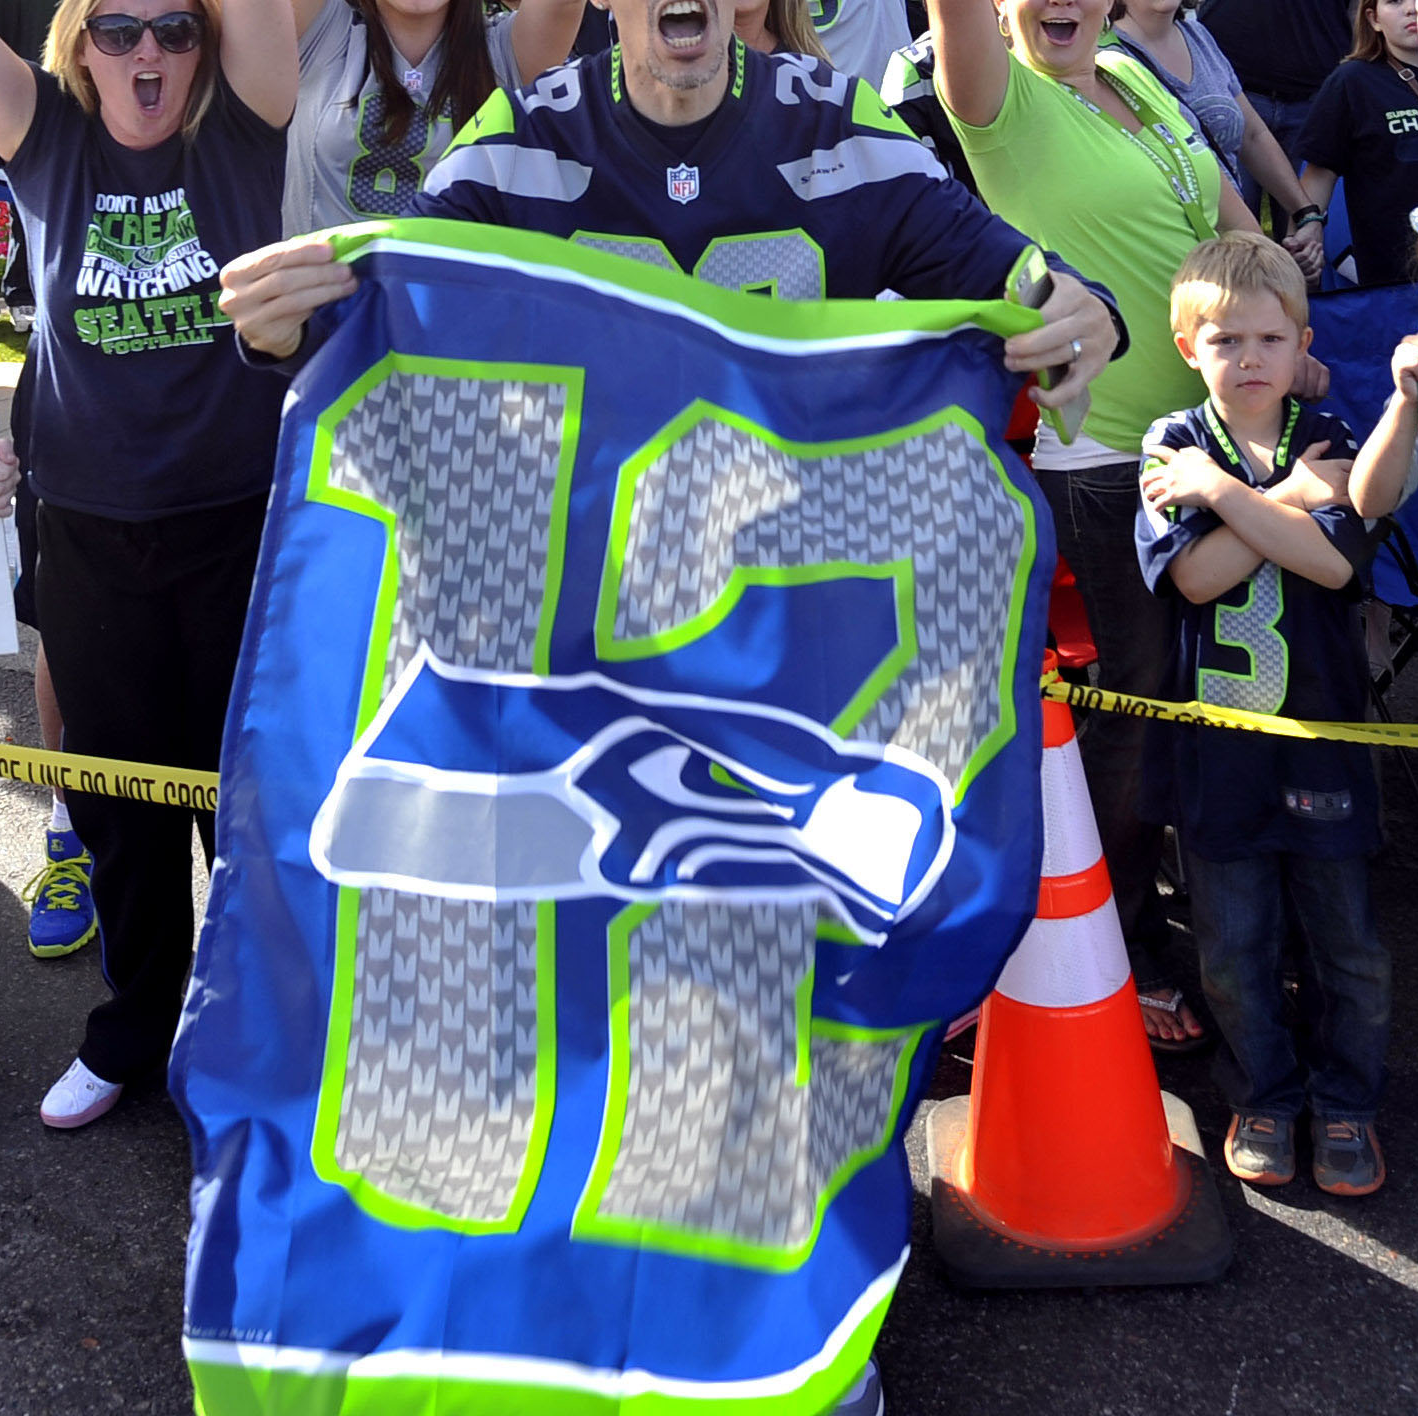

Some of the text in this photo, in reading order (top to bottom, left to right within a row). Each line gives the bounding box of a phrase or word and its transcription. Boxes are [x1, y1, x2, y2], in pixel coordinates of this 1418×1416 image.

[95, 193, 138, 214] DON'T
[672, 181, 696, 196] NFL
[75, 249, 220, 300] WATCHING
[73, 289, 233, 345] SEATTLE
[101, 326, 215, 355] FOOTBALL
[1197, 558, 1289, 716] 3
[28, 761, 73, 790] LINE
[306, 350, 1037, 1274] 12
